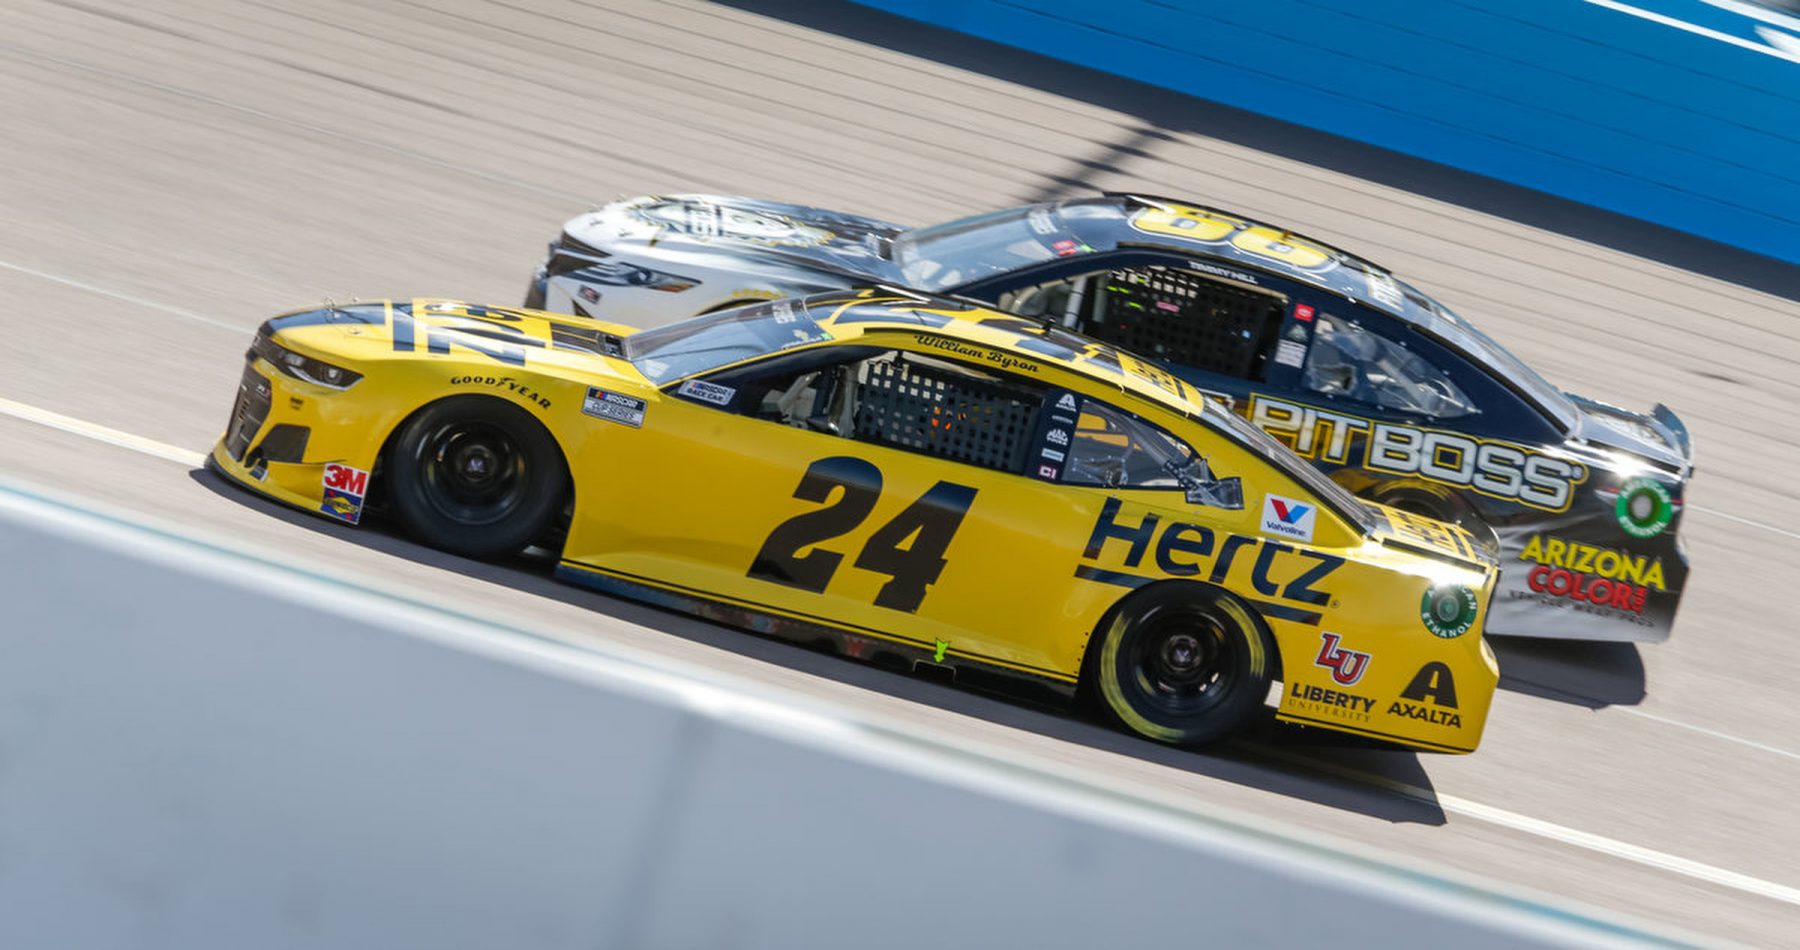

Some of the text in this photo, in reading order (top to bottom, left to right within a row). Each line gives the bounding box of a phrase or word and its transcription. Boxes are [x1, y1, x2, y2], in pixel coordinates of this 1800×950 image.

[914, 335, 1040, 373] William Byron
[1250, 394, 1574, 511] PIT BOSS
[324, 464, 367, 495] 3M
[746, 456, 979, 614] 24
[1266, 520, 1306, 537] Valvoline
[1083, 497, 1347, 606] Hertz
[1519, 534, 1666, 591] ARIZONA
[1528, 565, 1633, 612] COLOR
[1422, 612, 1471, 638] ETHANOL
[1288, 698, 1372, 723] UNIVERSITY
[1291, 682, 1377, 713] LIBERTY
[1387, 702, 1462, 729] AXALTA
